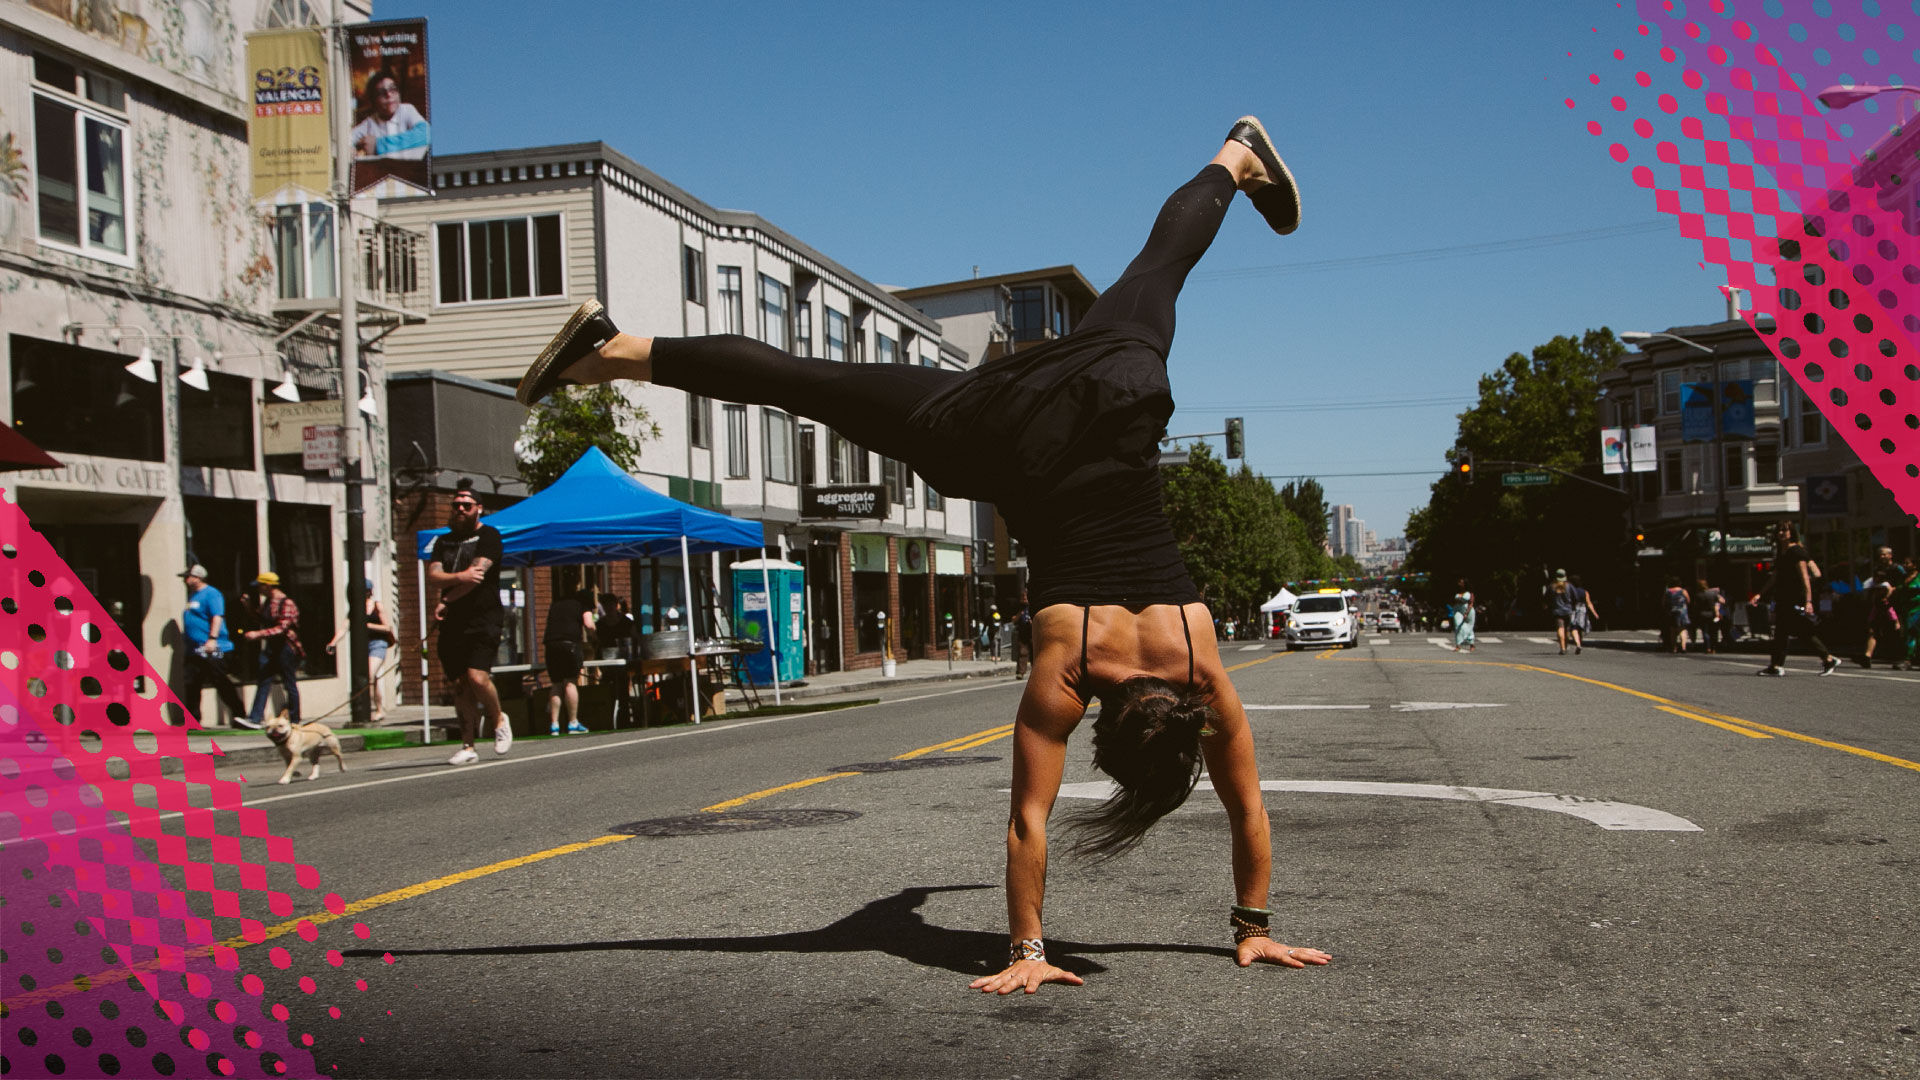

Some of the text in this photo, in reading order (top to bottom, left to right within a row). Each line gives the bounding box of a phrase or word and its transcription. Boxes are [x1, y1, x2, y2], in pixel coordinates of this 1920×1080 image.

[355, 32, 418, 45] We're writing
[363, 47, 378, 58] the
[255, 66, 320, 89] 826
[256, 89, 321, 102] VALENCIA
[257, 103, 322, 116] 15 YEARS
[280, 405, 322, 417] PAXTON
[116, 466, 166, 491] GATE
[1524, 474, 1547, 482] Street
[817, 491, 875, 505] aggregate
[838, 500, 875, 514] supply
